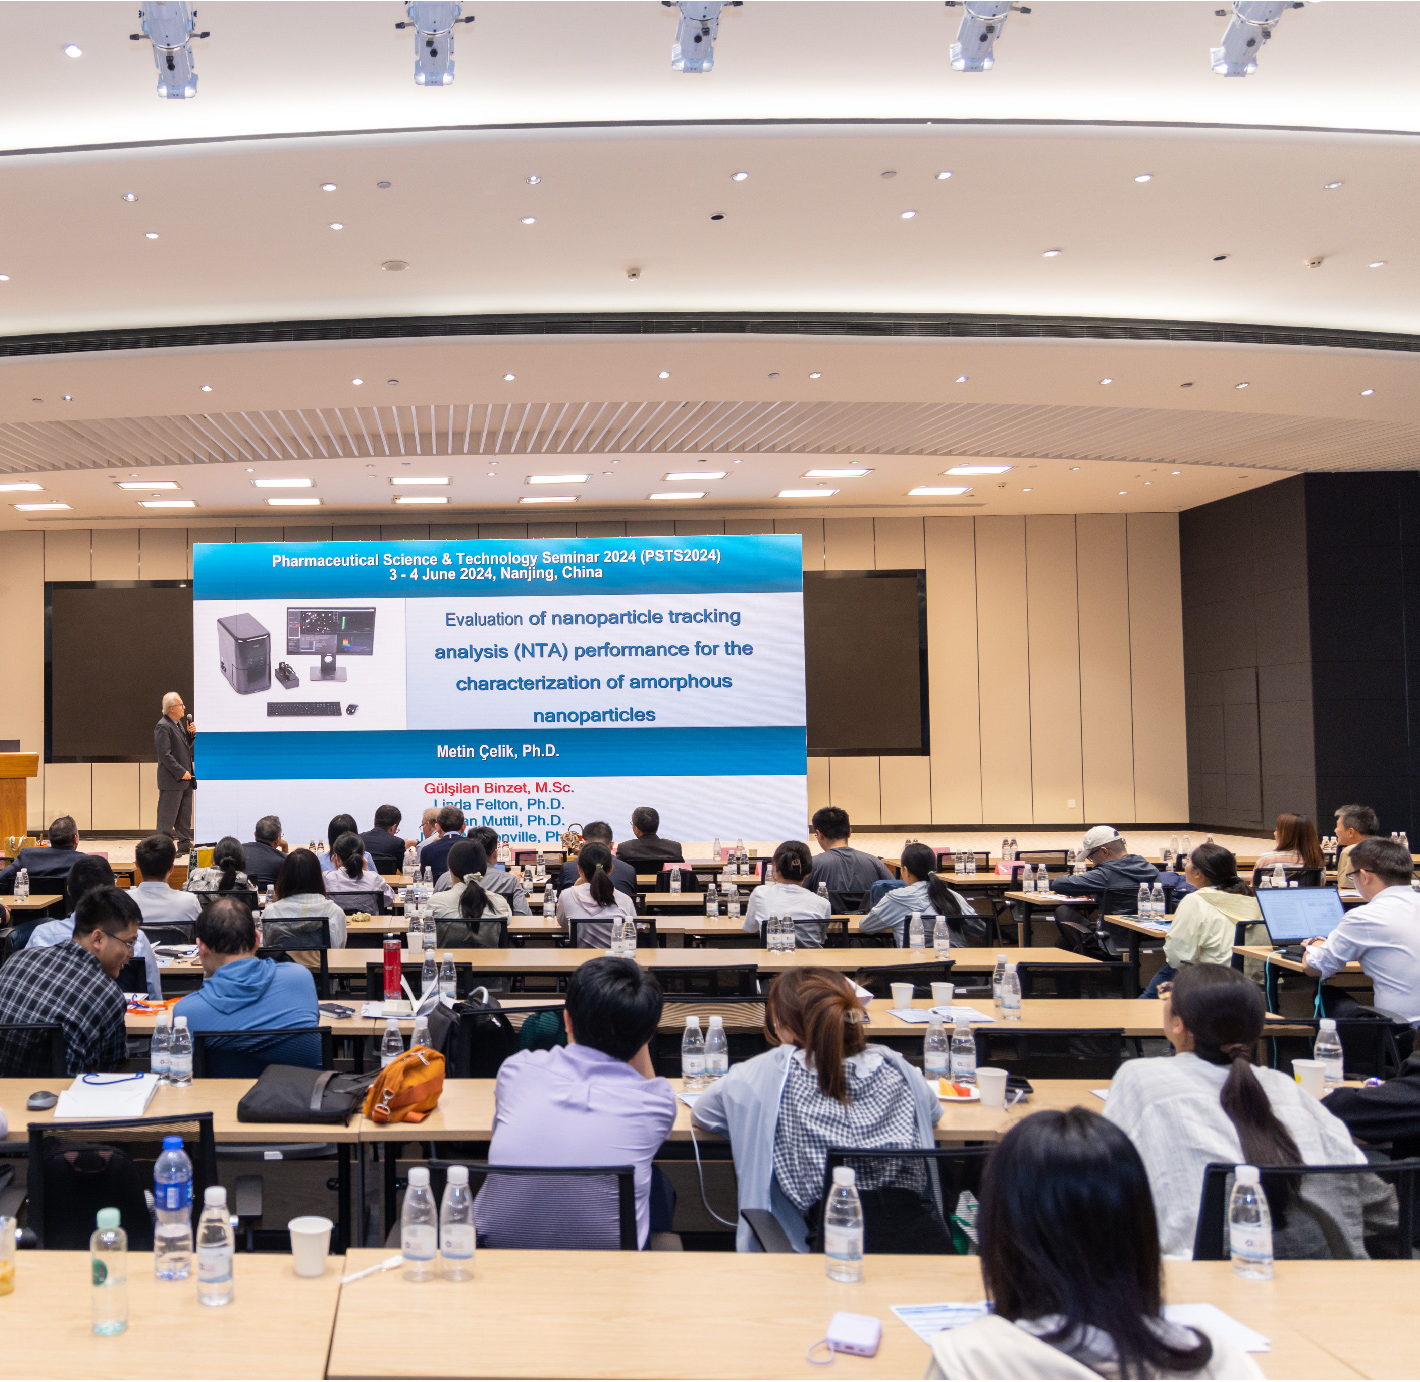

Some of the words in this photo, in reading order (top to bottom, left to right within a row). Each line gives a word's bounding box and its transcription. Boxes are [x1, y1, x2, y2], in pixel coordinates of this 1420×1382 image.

[272, 553, 379, 569] Pharmaceutical
[383, 553, 438, 567] Science
[441, 552, 453, 567] &
[455, 551, 539, 570] Technology
[542, 550, 601, 565] Seminar
[603, 549, 637, 564] 2024
[640, 548, 721, 567] (PSTS2024)
[389, 568, 398, 582] 3
[409, 567, 419, 581] 4
[422, 567, 456, 581] June
[459, 566, 496, 583] 2024,
[500, 564, 558, 582] Nanjing,
[561, 565, 603, 579] China
[445, 611, 523, 627] Evaluation
[528, 610, 547, 626] of
[551, 609, 664, 628] nanoparticle
[667, 608, 741, 627] tracking
[434, 643, 509, 663] analysis
[514, 642, 568, 662] (NTA)
[574, 641, 690, 661] performance
[694, 640, 720, 656] for
[723, 640, 754, 656] the
[455, 674, 601, 691] characterization
[606, 674, 626, 690] of
[629, 673, 733, 692] amorphous
[533, 706, 656, 726] nanoparticles
[437, 744, 475, 758] Metin
[479, 744, 518, 761] Çelik,
[522, 743, 560, 758] Ph.D.
[424, 782, 480, 797] Gülşilan
[484, 782, 531, 795] Binzet,
[535, 781, 575, 794] M.Sc.
[475, 798, 523, 812] Felton,
[527, 797, 565, 811] Ph.D.
[481, 814, 523, 828] Muttil,
[527, 814, 565, 827] Ph.D.
